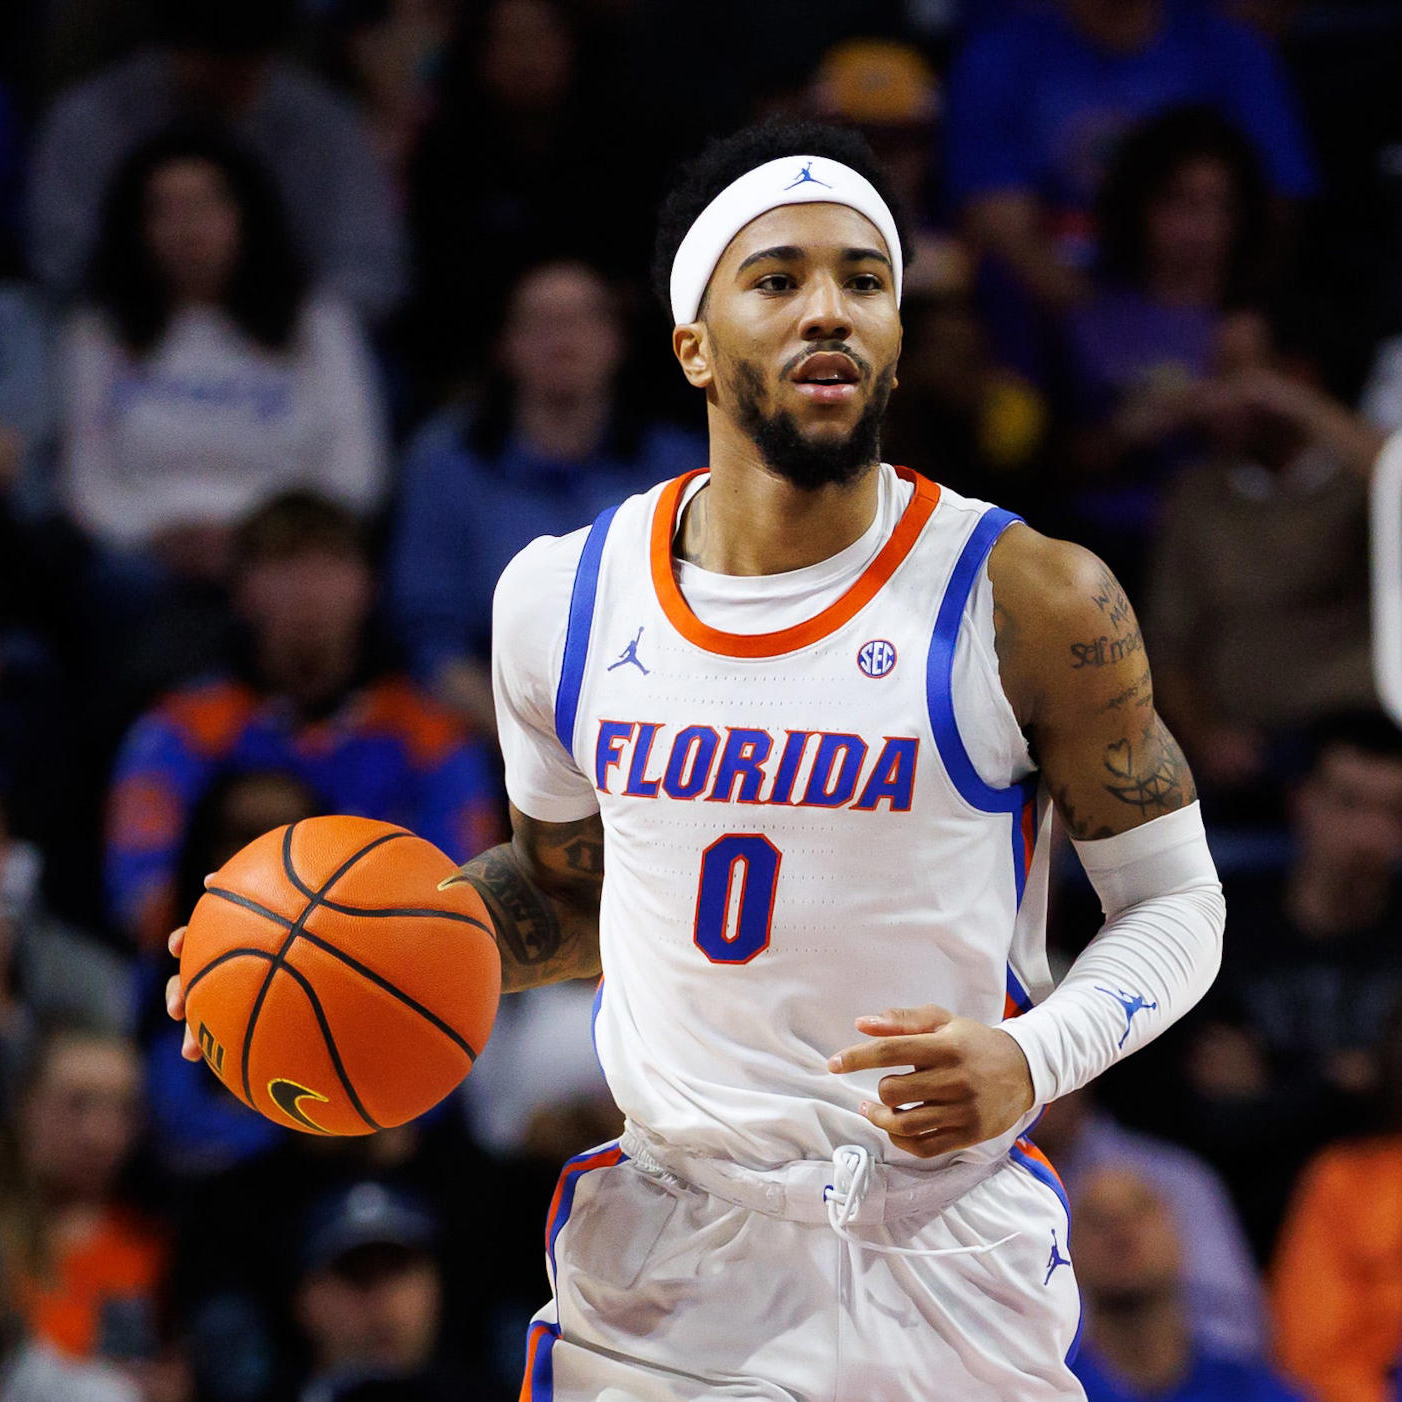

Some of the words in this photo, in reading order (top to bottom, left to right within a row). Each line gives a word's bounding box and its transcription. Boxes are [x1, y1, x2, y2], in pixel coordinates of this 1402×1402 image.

[858, 640, 896, 677] SEC
[595, 718, 920, 812] FLORIDA
[693, 832, 783, 965] 0
